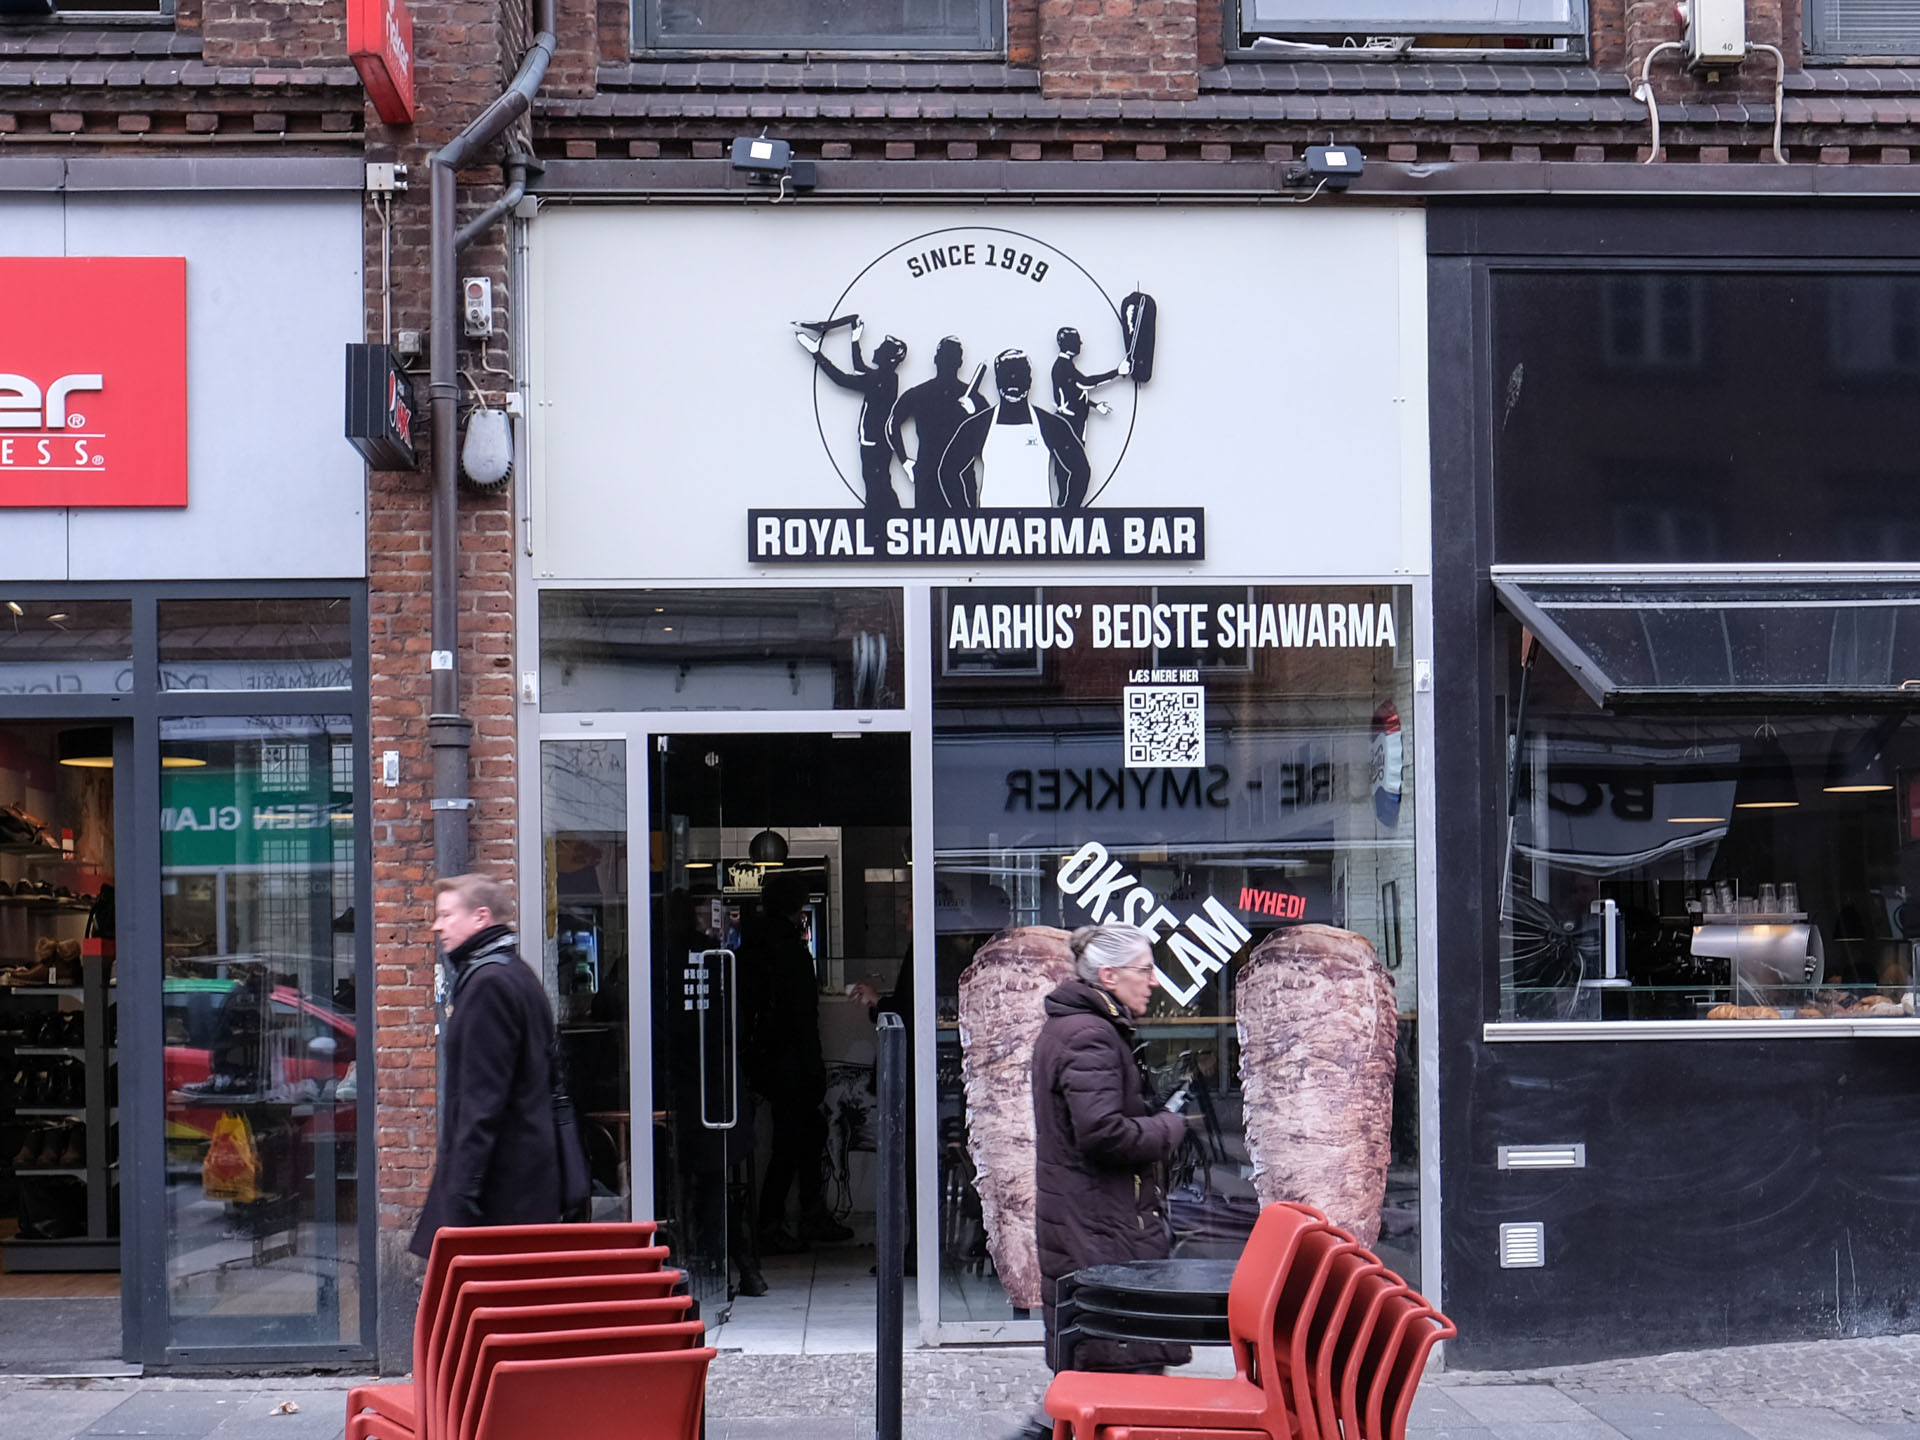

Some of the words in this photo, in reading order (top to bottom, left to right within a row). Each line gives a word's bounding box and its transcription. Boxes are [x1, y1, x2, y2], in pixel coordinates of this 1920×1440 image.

[1722, 43, 1733, 51] 40
[906, 244, 976, 278] SINCE
[984, 244, 1050, 283] 1999
[757, 517, 875, 556] ROYAL
[886, 516, 1111, 556] SHAWARMA
[1123, 516, 1197, 555] BAR
[1092, 604, 1209, 649] BEDSTE
[1217, 603, 1397, 649] SHAWARMA
[1128, 669, 1150, 683] LÆS
[1151, 669, 1178, 683] MERE
[1179, 669, 1199, 683] HER
[1239, 887, 1306, 920] NYHED!
[1153, 896, 1252, 1007] LAM
